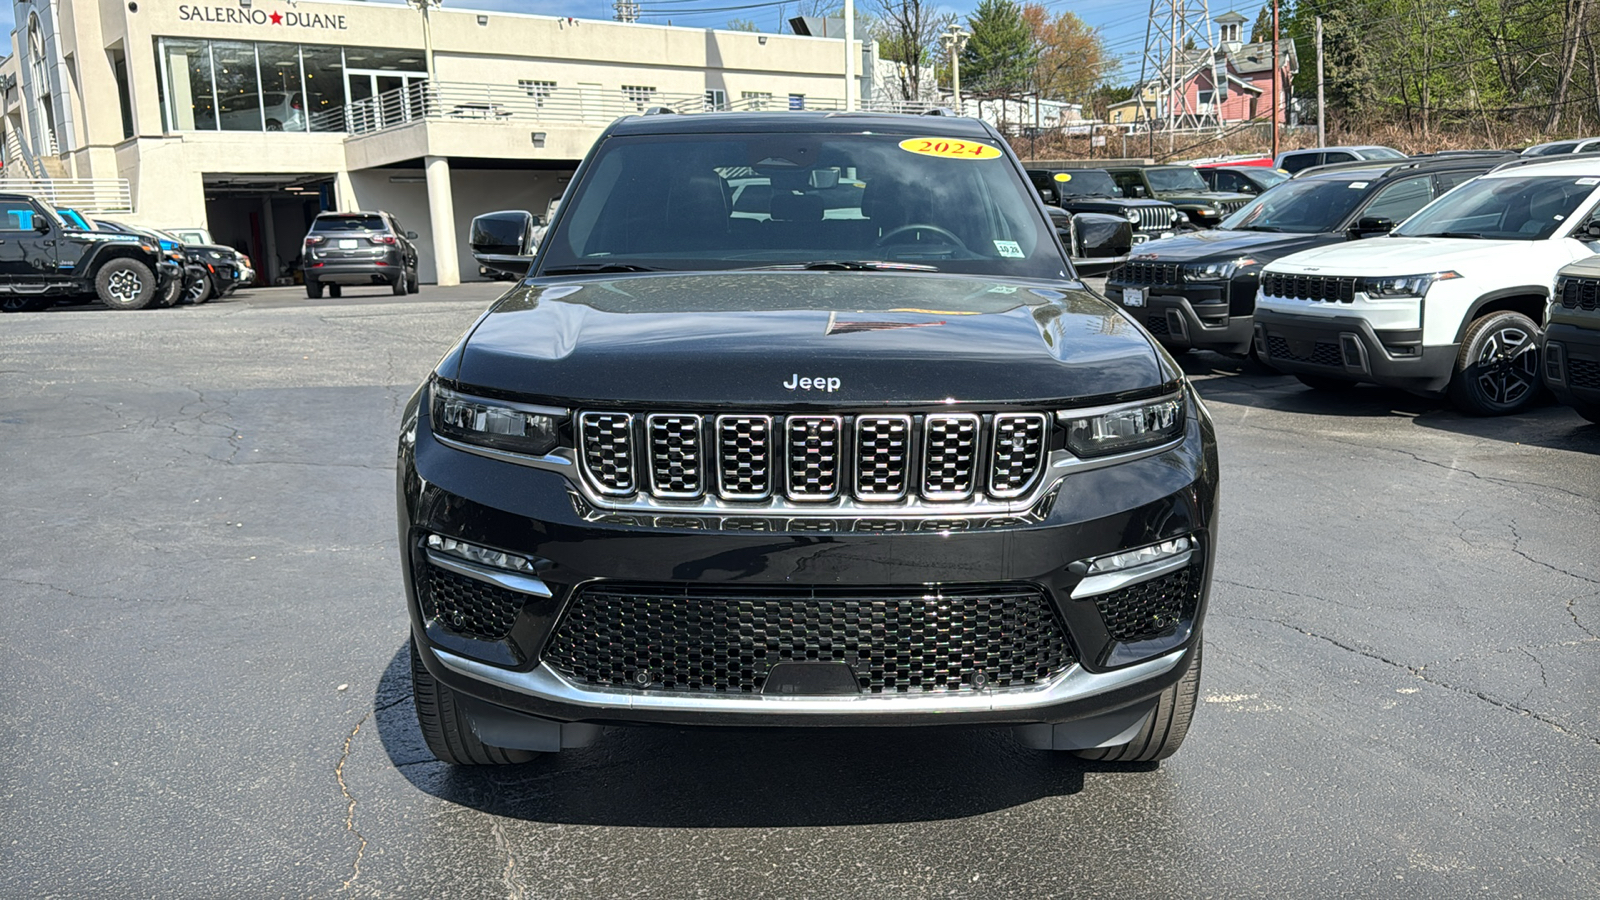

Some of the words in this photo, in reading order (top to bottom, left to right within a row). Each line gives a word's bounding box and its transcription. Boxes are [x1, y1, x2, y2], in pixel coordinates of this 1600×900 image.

[179, 5, 267, 25] SALERNO
[285, 12, 348, 30] DUANE
[917, 141, 984, 156] 2024
[783, 373, 841, 393] Jeep
